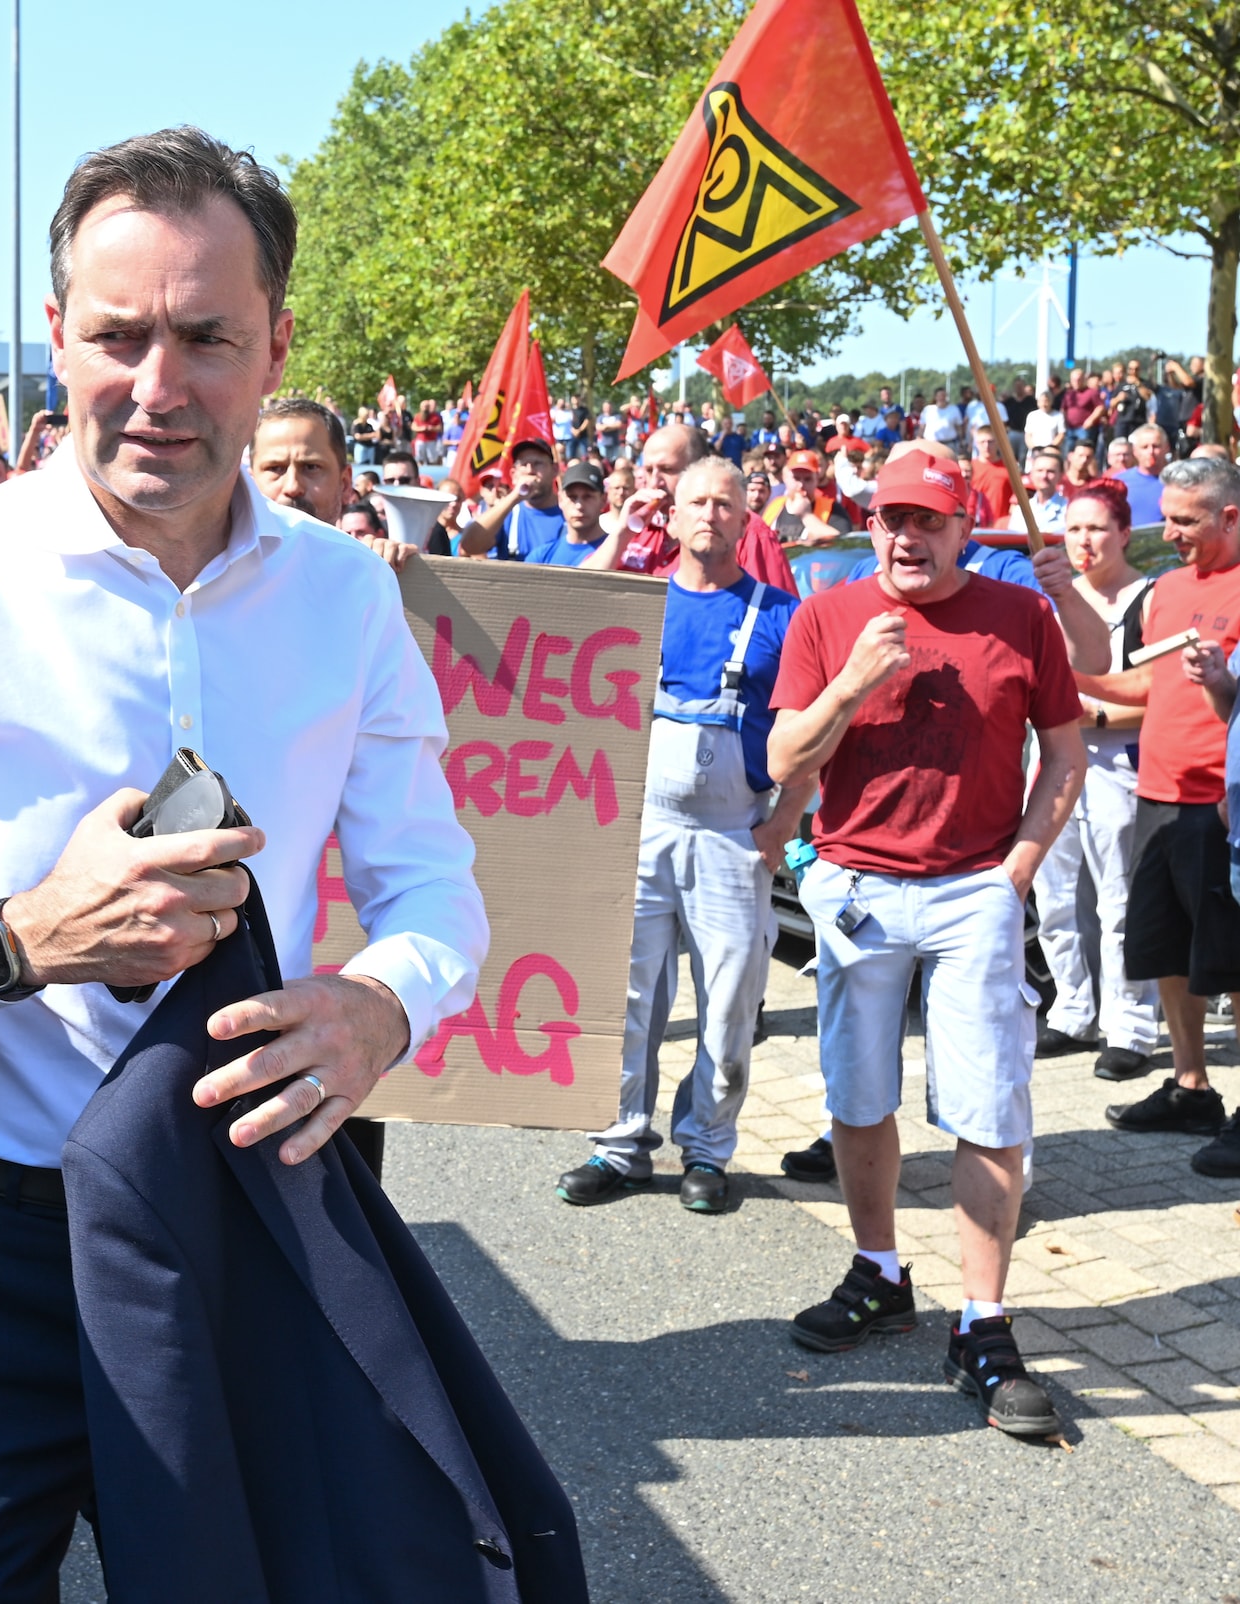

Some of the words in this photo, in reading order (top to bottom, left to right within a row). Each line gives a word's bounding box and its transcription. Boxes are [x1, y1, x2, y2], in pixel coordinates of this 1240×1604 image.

[432, 614, 642, 732] WEG
[439, 739, 620, 827] REM
[412, 952, 583, 1087] AG
